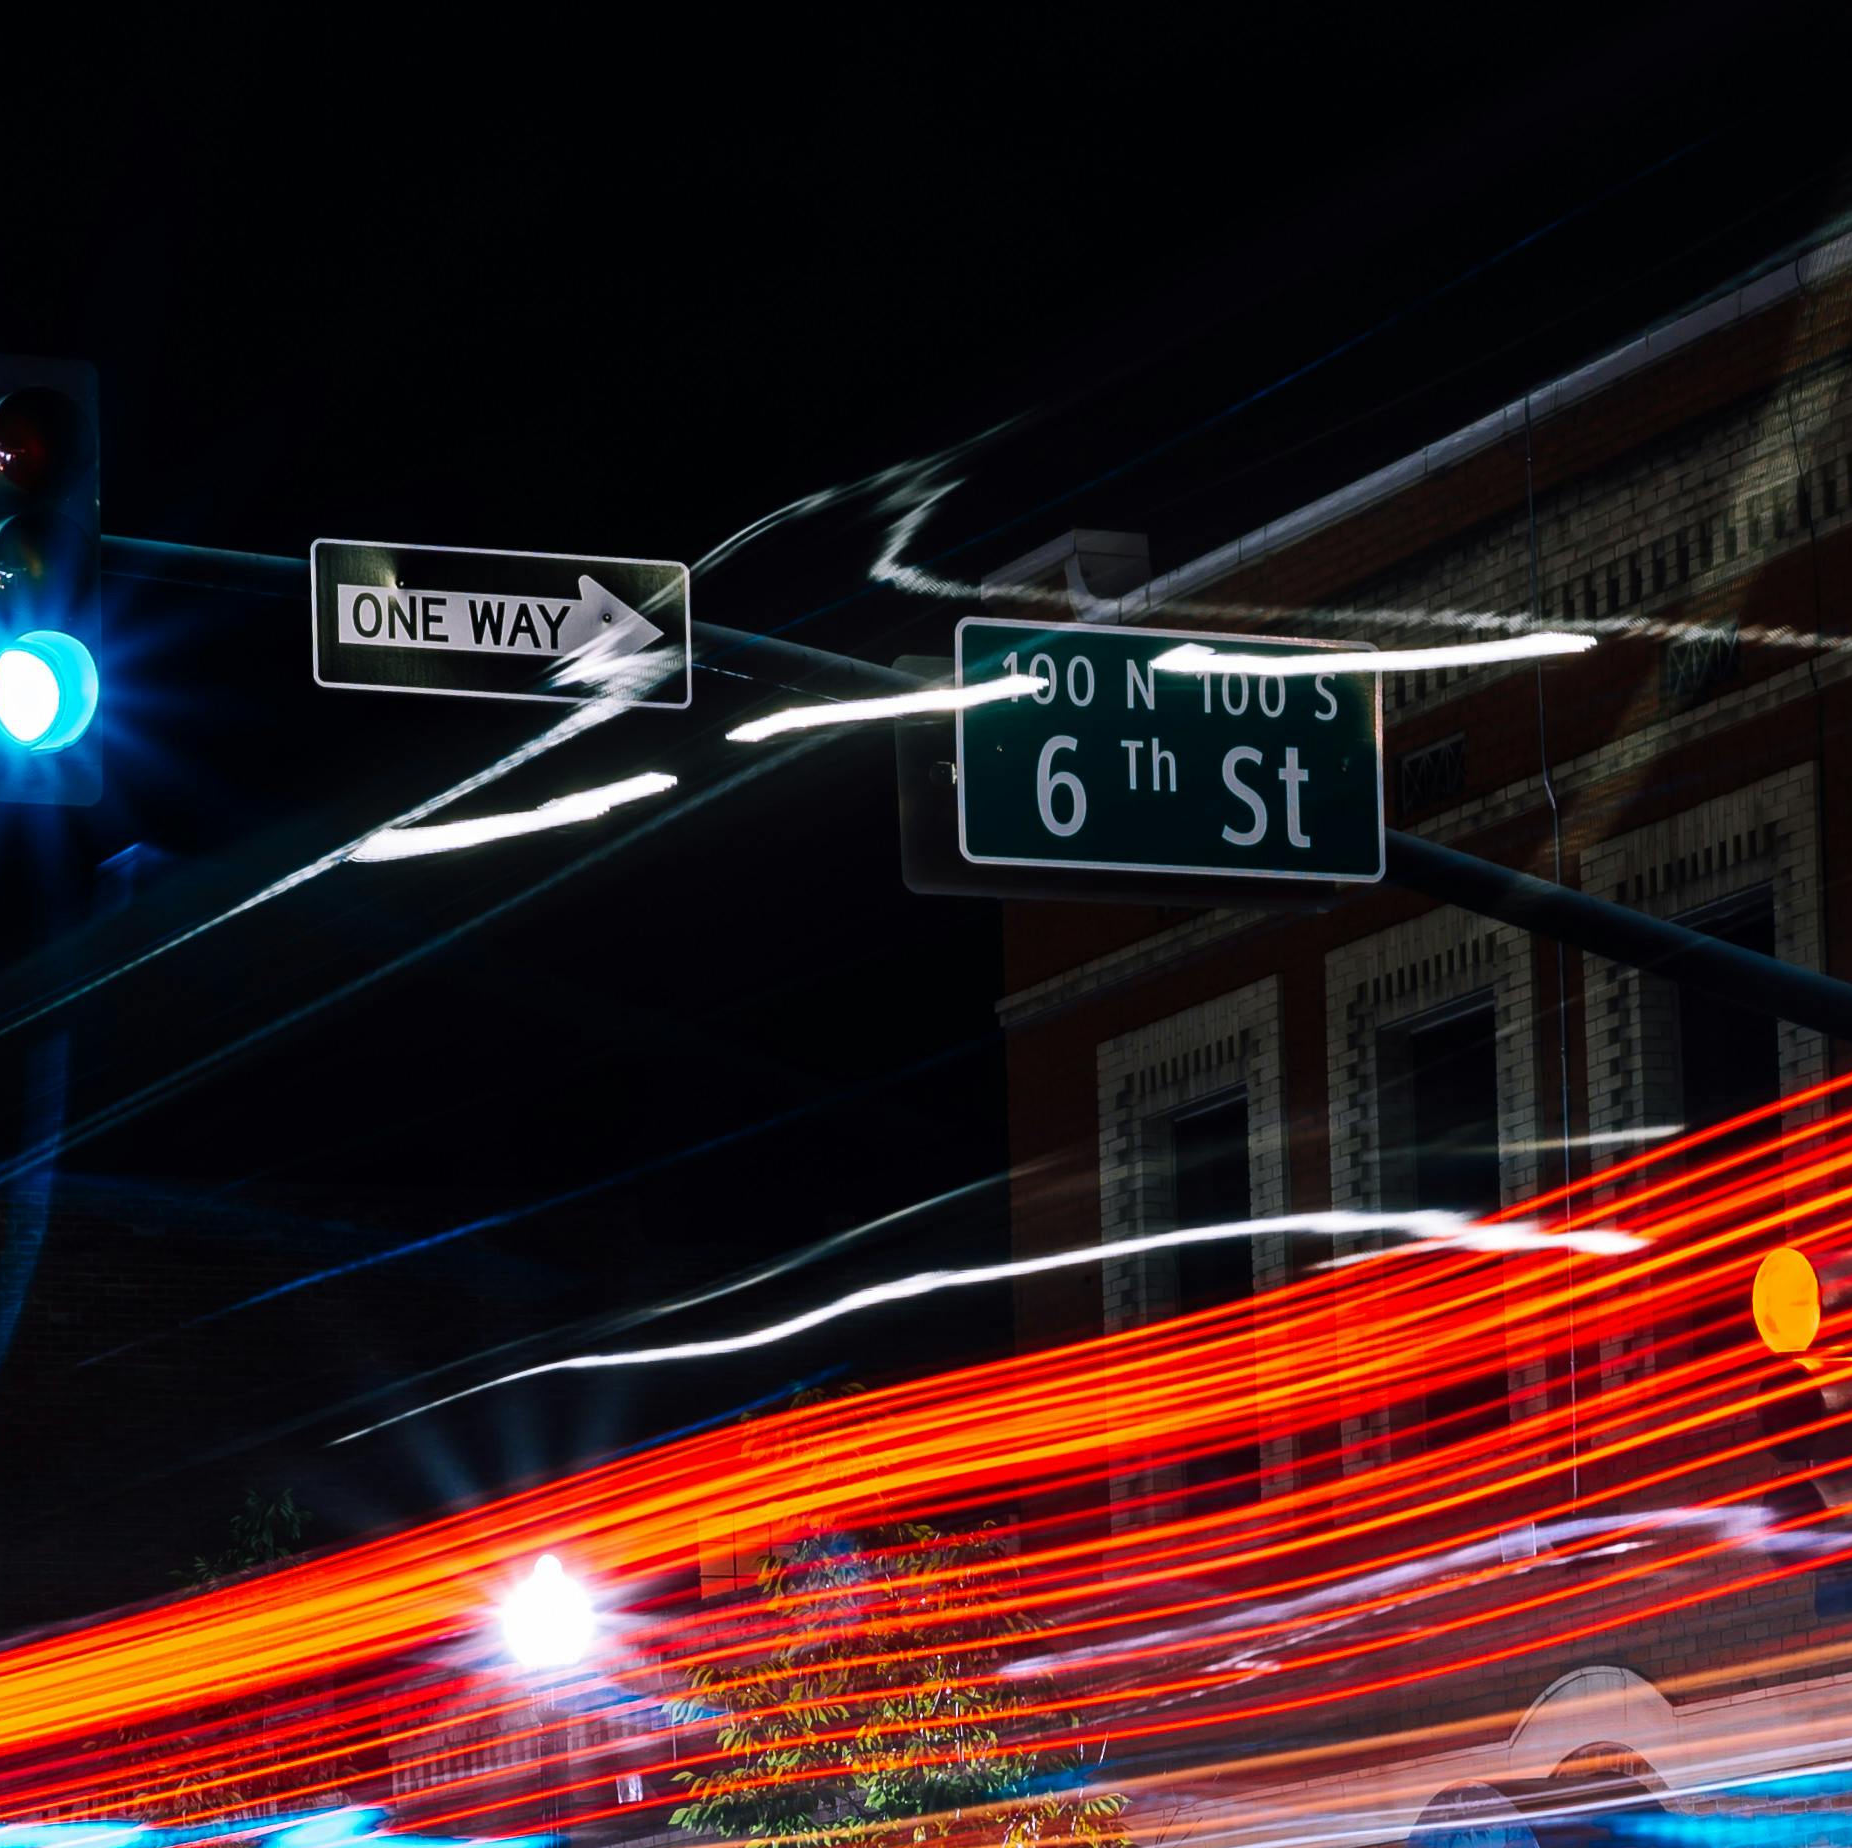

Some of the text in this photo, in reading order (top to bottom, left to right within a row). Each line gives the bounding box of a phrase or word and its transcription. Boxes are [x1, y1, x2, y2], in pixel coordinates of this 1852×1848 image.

[352, 592, 571, 650] ONE WAY
[1002, 651, 1339, 722] 100 N 100 S
[1036, 734, 1311, 849] 6 Th St
